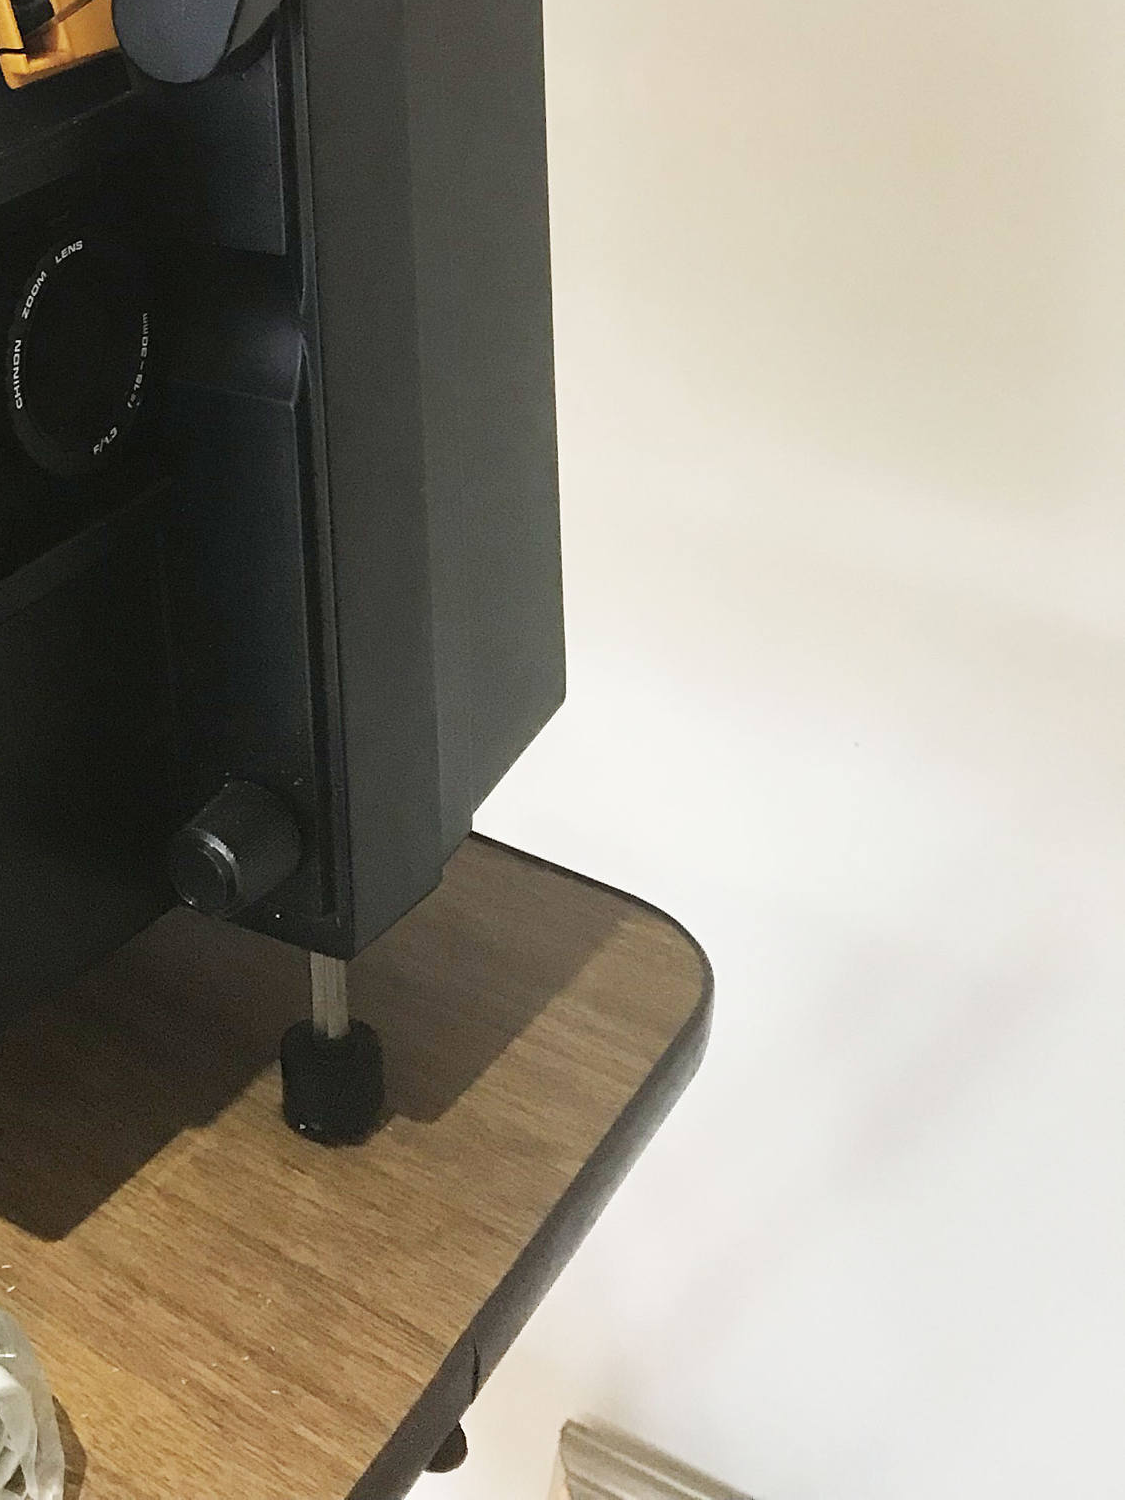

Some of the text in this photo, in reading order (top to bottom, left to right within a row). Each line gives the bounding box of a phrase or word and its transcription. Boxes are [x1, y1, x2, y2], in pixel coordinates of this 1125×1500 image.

[12, 240, 83, 410] CHINON ZOOM LENS
